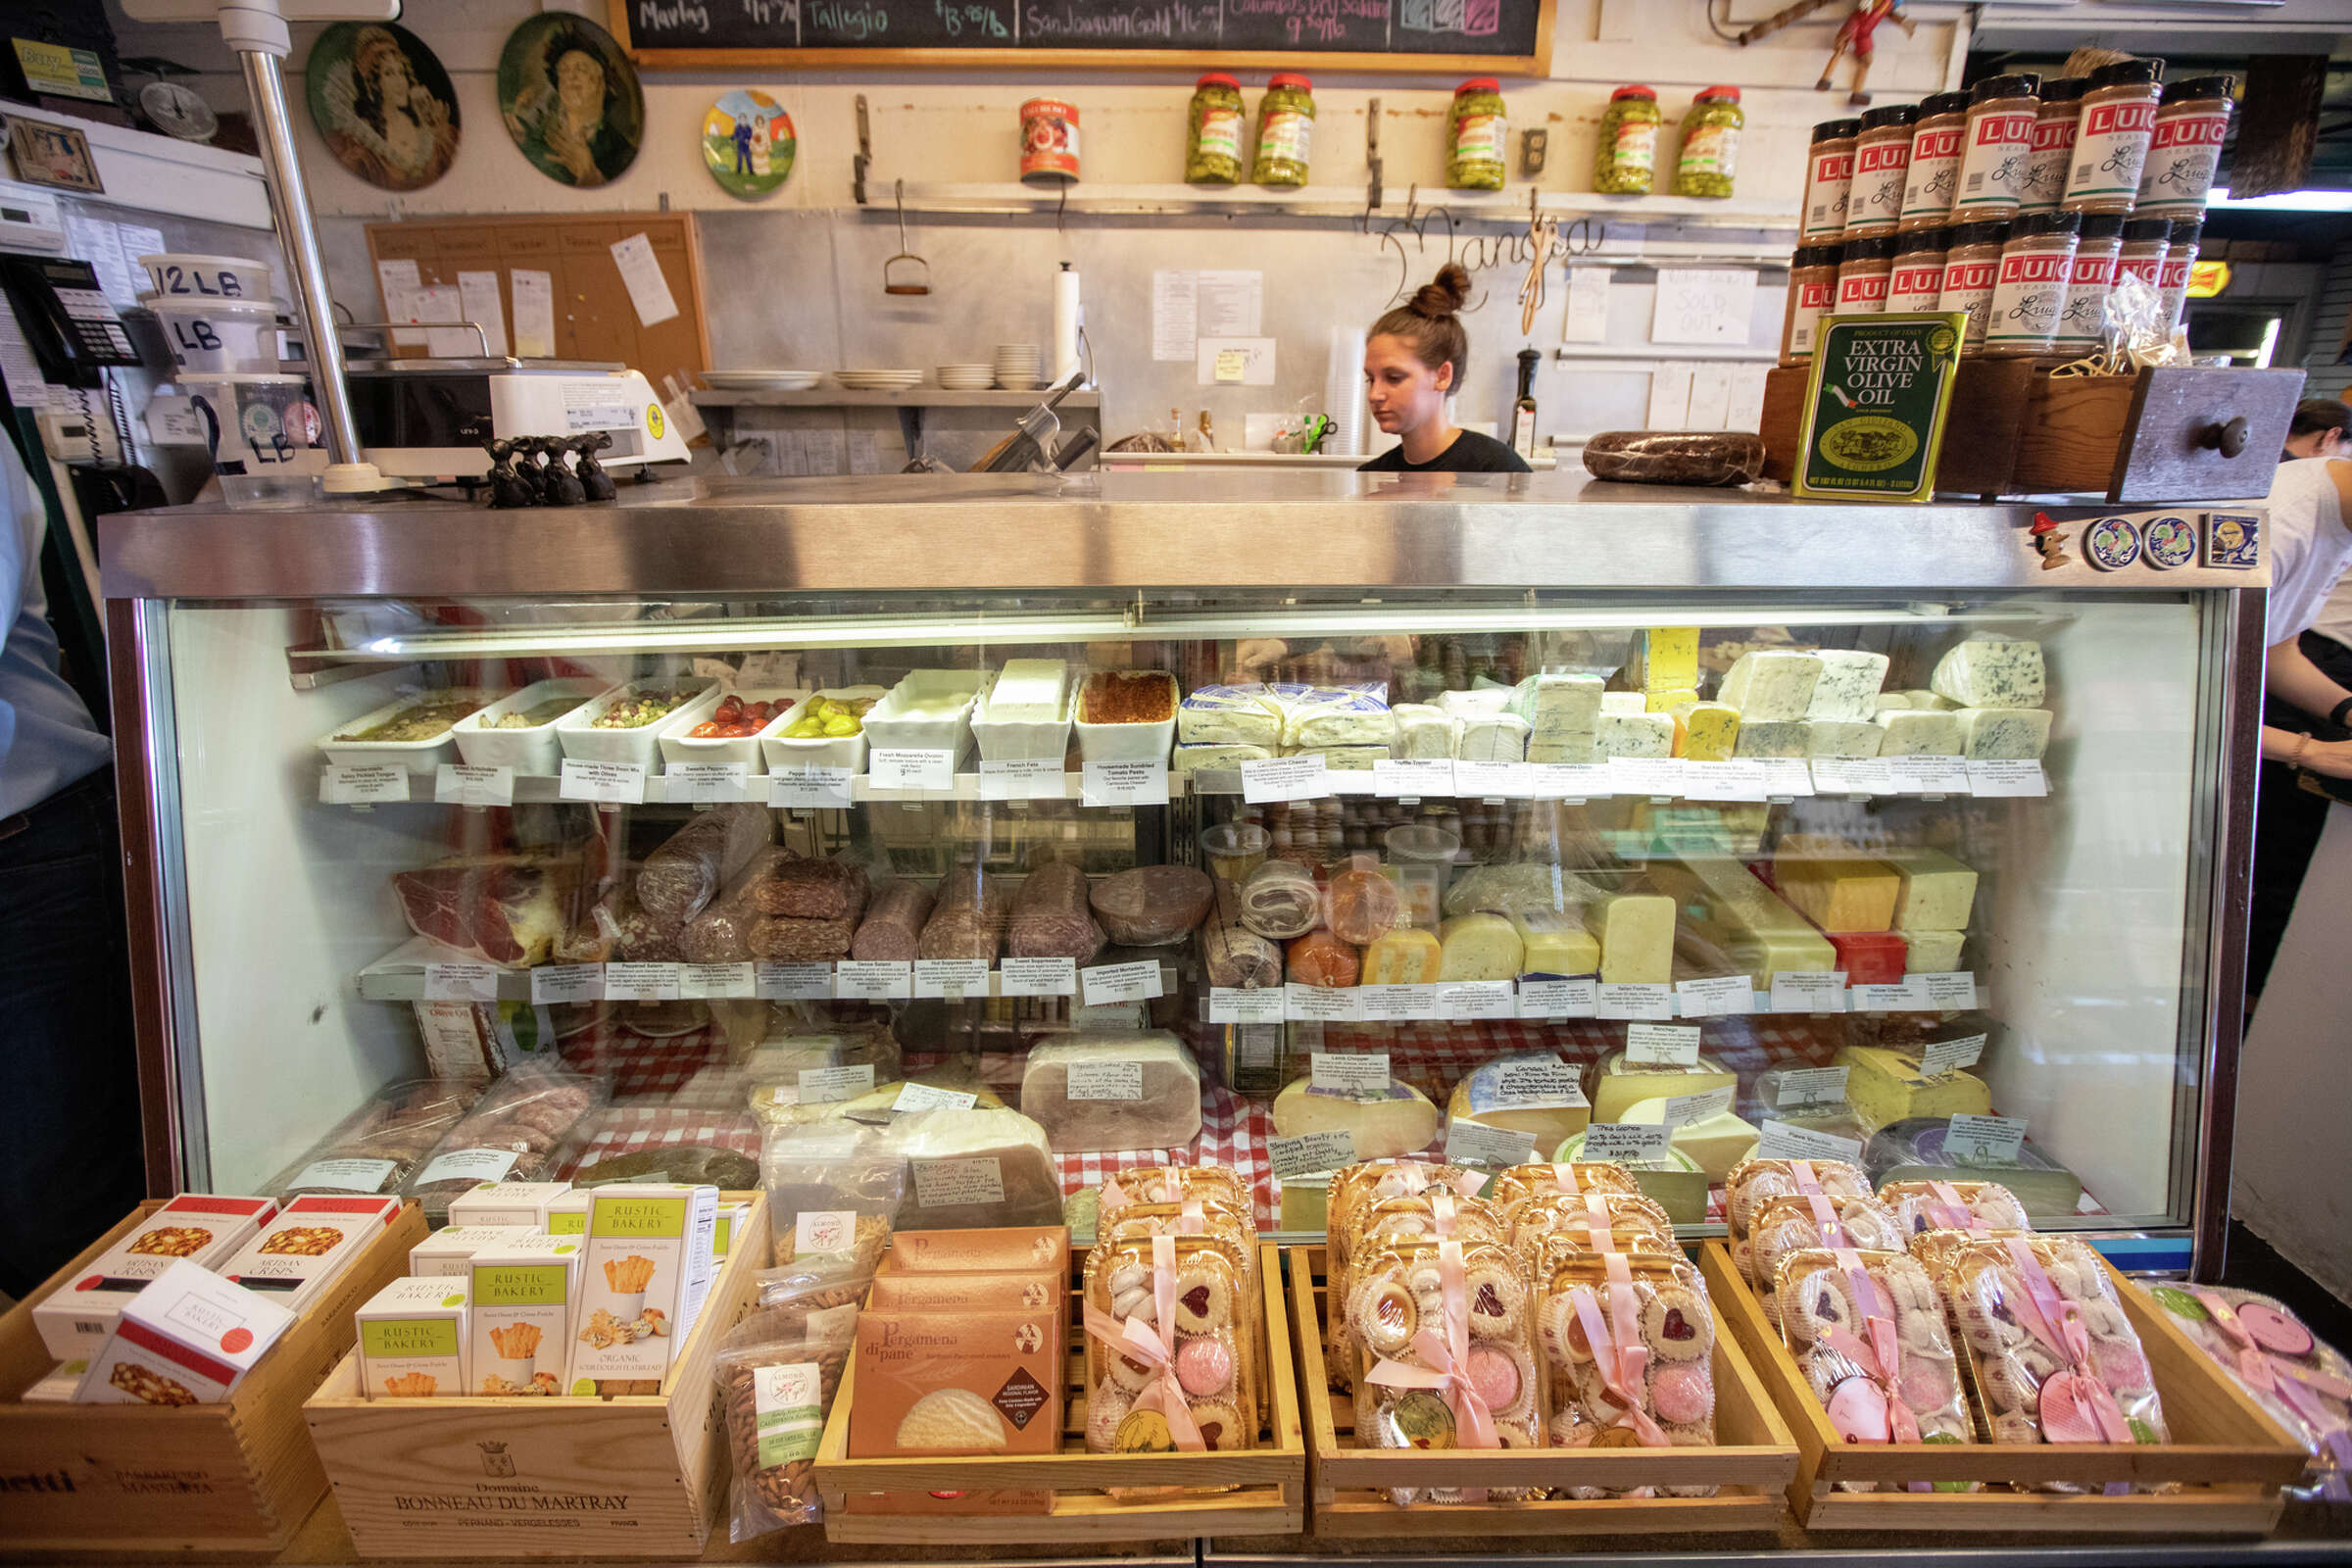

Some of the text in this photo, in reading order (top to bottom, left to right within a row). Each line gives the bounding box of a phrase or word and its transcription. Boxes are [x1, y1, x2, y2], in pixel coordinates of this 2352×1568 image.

[194, 270, 242, 297] LB
[1849, 339, 1922, 356] EXTRA
[1844, 356, 1924, 372] VIRGIN
[1846, 372, 1914, 389] OLIVE
[1857, 389, 1896, 405] OIL
[613, 1206, 662, 1217] RUSTIC
[612, 1219, 662, 1230] BAKERY
[494, 1274, 543, 1286] RUSTIC
[493, 1286, 545, 1298] BAKERY
[383, 1327, 434, 1338] RUSTIC
[881, 1321, 958, 1348] Pergamena
[383, 1339, 436, 1350] BAKERY
[865, 1342, 879, 1356] di
[599, 1354, 641, 1364] ORGANIC
[879, 1348, 914, 1363] pane
[475, 1482, 540, 1494] Domaine
[395, 1495, 629, 1511] BONNEAU DU MARTRAY
